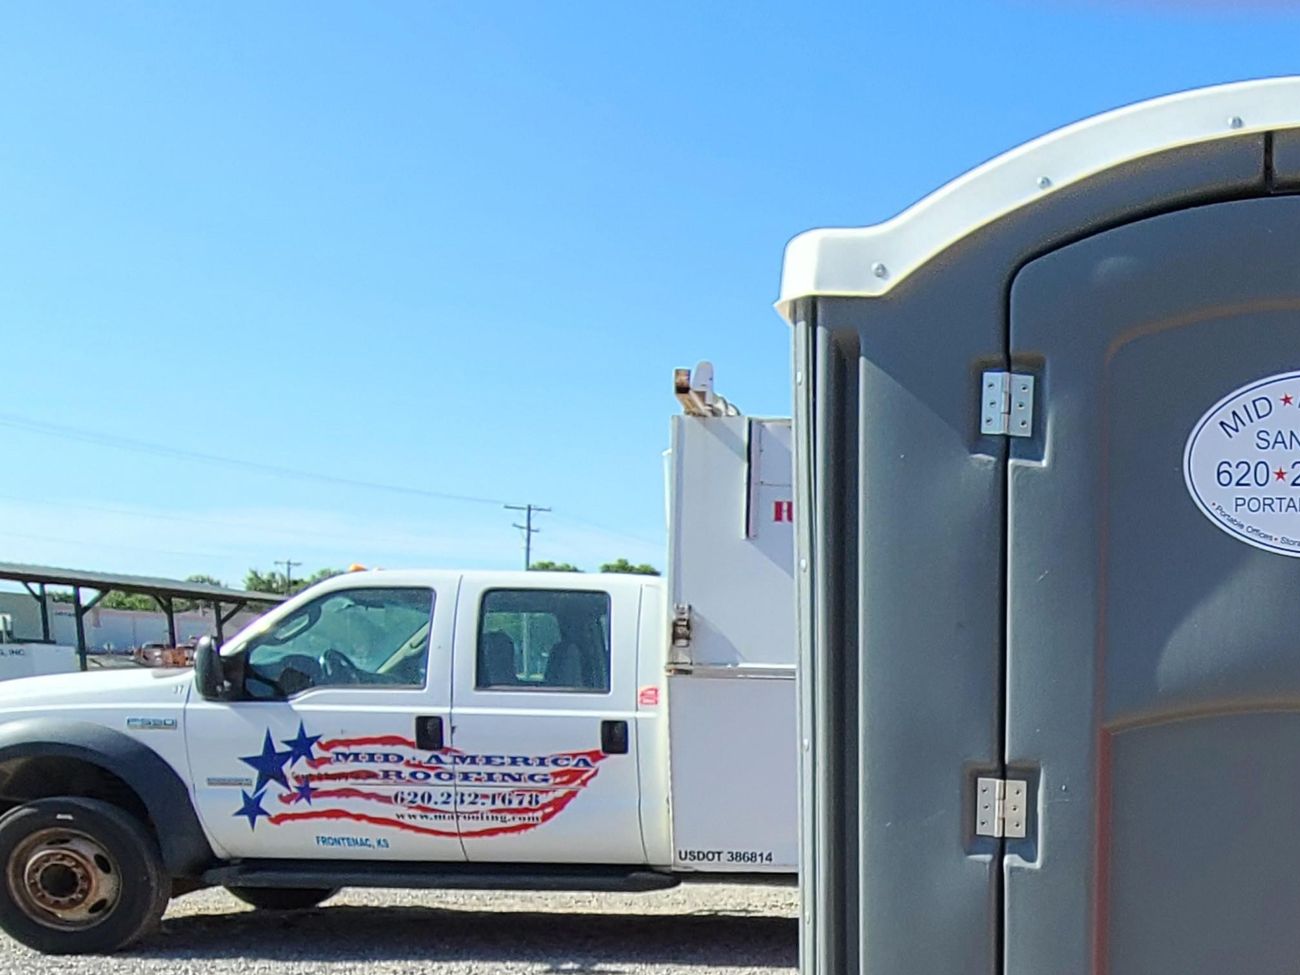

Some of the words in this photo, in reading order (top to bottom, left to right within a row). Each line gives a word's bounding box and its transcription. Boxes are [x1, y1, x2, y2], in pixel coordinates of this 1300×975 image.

[1218, 396, 1273, 439] MID
[1216, 461, 1270, 488] 620
[1215, 505, 1245, 530] Portable
[1246, 525, 1273, 541] Offices
[332, 751, 404, 763] MID
[424, 754, 595, 768] AMERICA
[379, 769, 551, 784] ROOFING
[392, 790, 541, 807] 620.232.1678
[678, 850, 723, 862] USDOT
[726, 851, 773, 863] 386814
